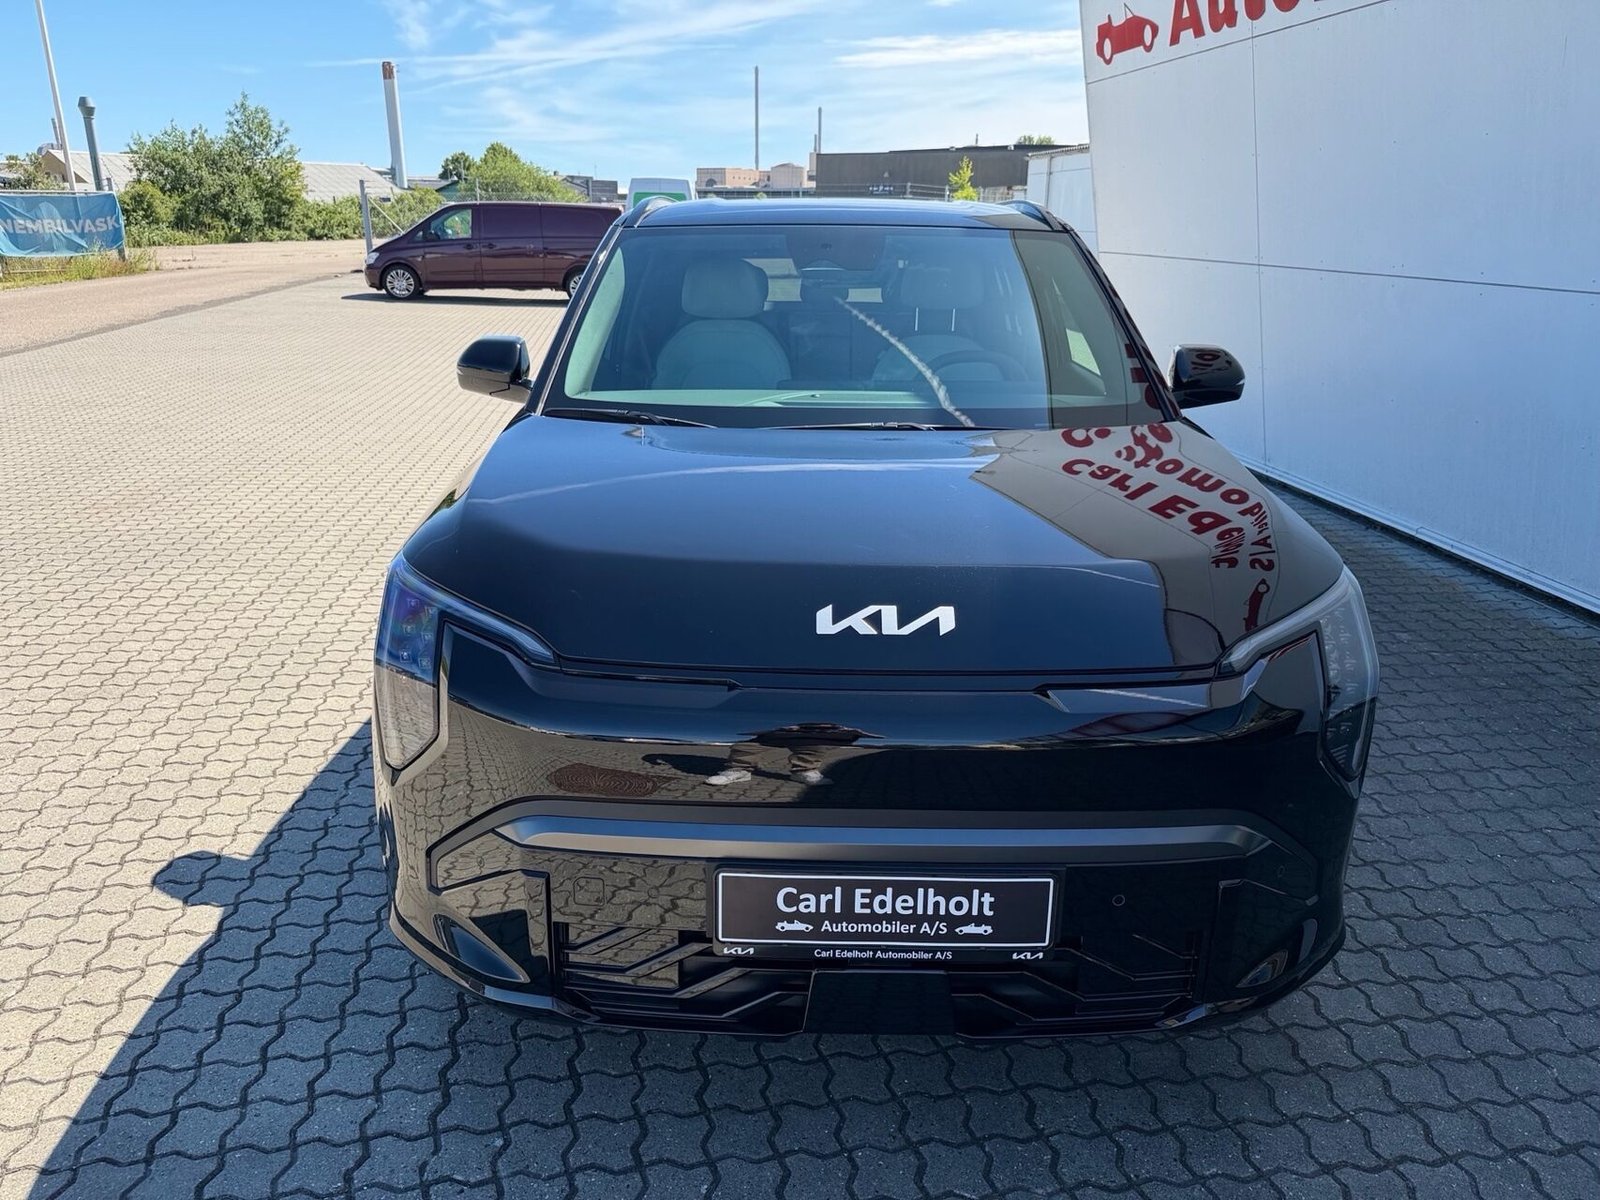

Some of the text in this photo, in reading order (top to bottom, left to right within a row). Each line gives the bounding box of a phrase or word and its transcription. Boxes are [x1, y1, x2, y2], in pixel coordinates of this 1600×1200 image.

[816, 604, 956, 636] KIA
[776, 886, 995, 916] Carl Edelholt
[821, 920, 948, 936] Automobiler A/S
[723, 946, 754, 955] KIA
[814, 949, 953, 961] Carl Edelholt Automobiler A/S
[1012, 951, 1043, 961] KIA
